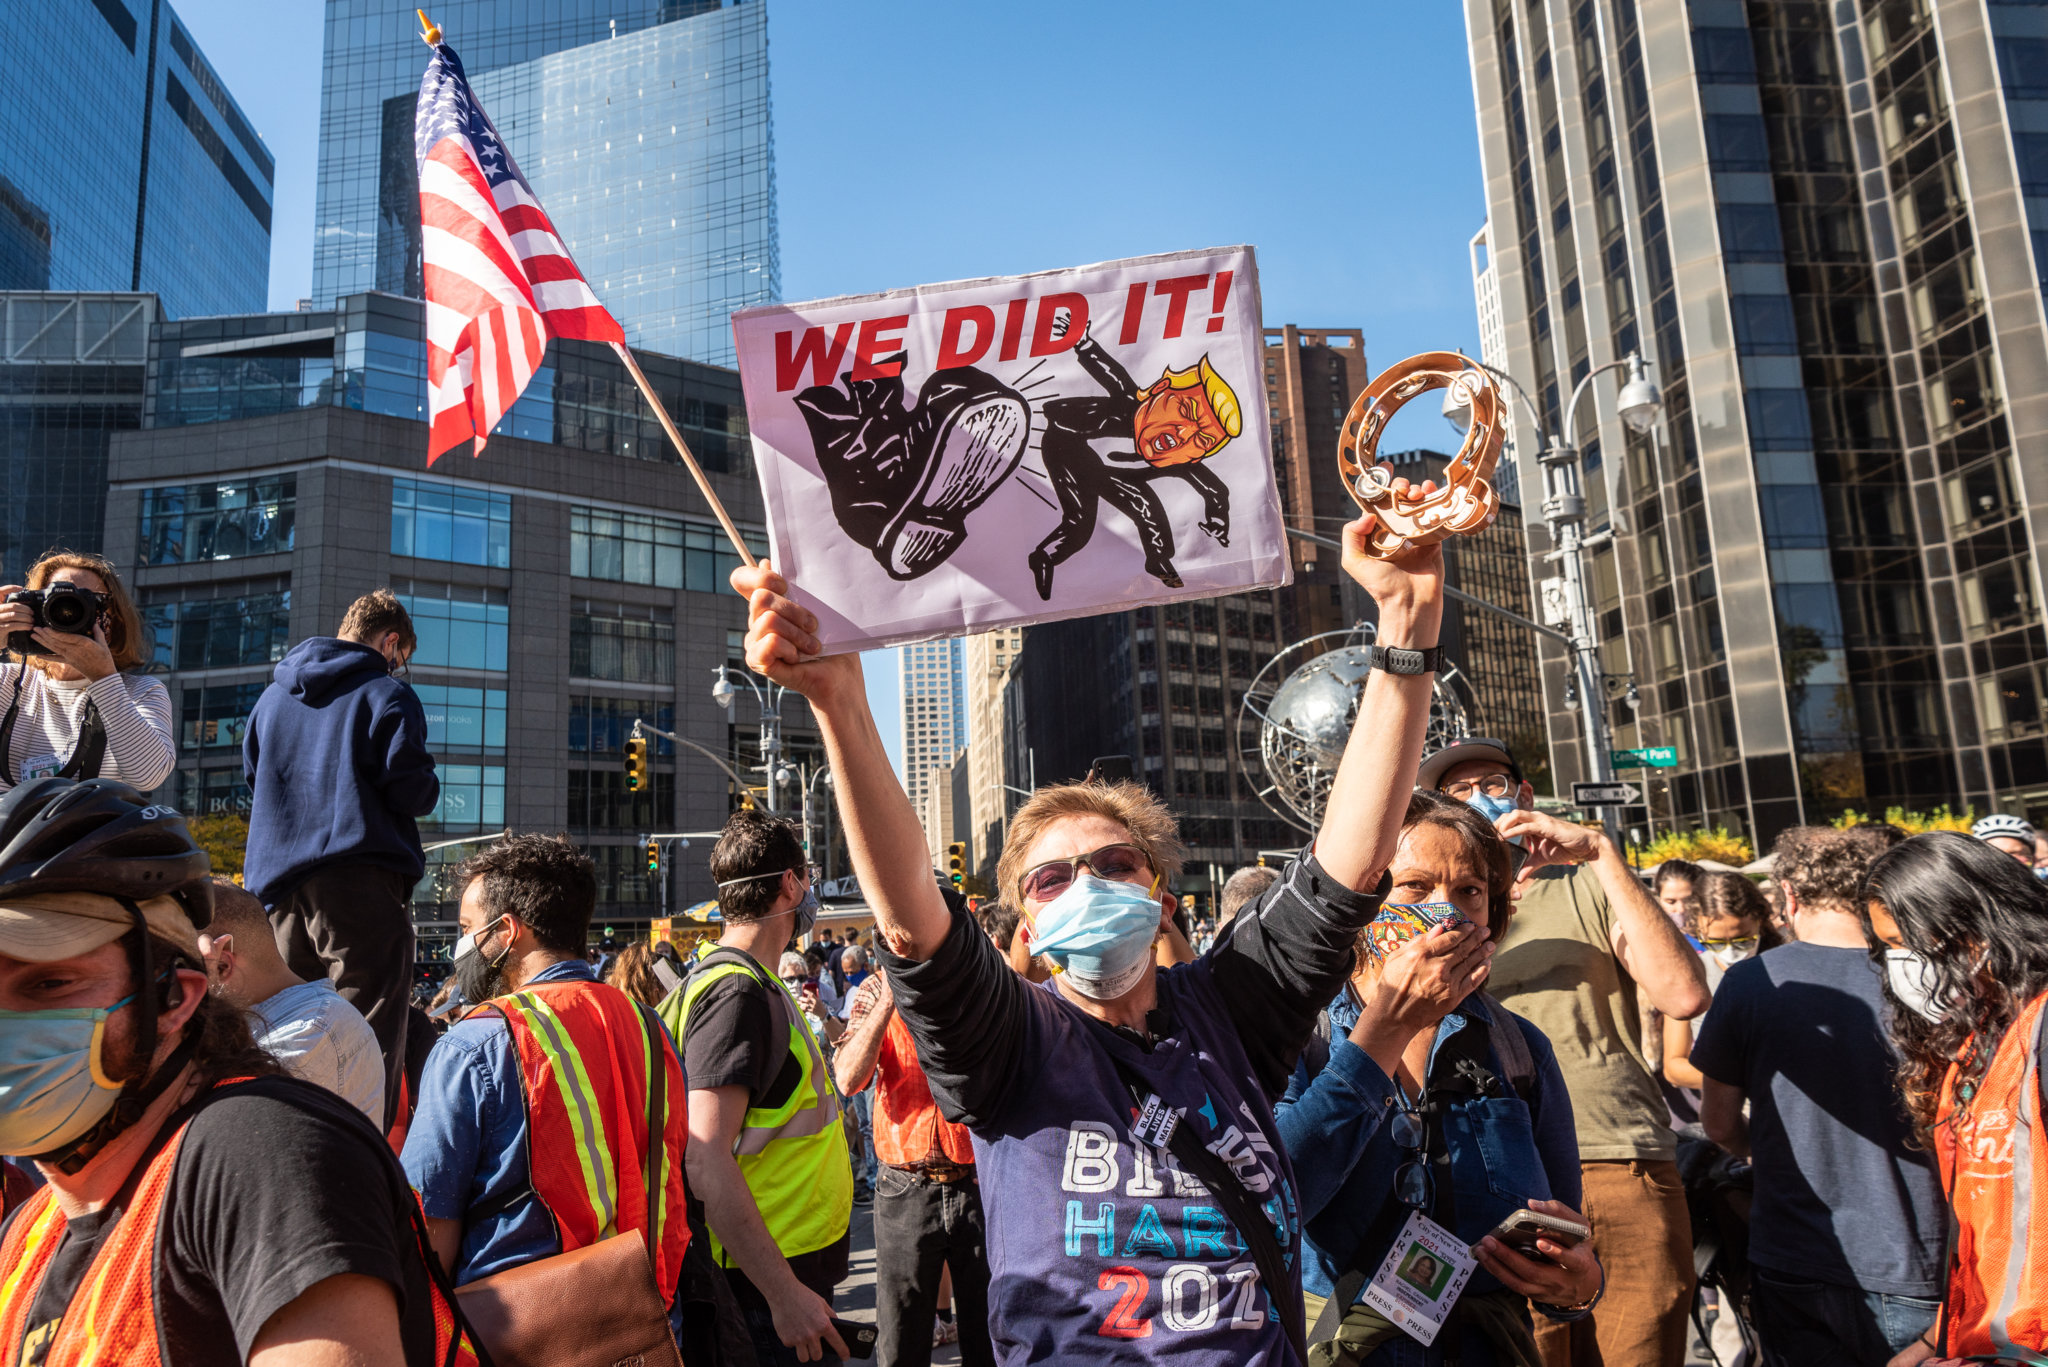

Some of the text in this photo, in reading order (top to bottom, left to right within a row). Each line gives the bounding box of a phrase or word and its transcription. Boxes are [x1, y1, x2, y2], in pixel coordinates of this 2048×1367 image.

[774, 270, 1234, 392] WE DID IT!
[1613, 749, 1672, 762] Central Park
[1583, 789, 1633, 801] ONE WAY
[1140, 1102, 1157, 1129] BLACK
[1150, 1108, 1166, 1132] LIVES
[1159, 1109, 1178, 1141] MATTER
[1377, 1229, 1412, 1284] PRESS
[1418, 1222, 1430, 1235] City
[1431, 1232, 1440, 1240] of
[1440, 1236, 1452, 1248] New
[1453, 1245, 1468, 1260] York
[1418, 1235, 1440, 1253] 2021
[1433, 1267, 1469, 1323] PRESS
[1367, 1290, 1433, 1340] PRESS PRESS
